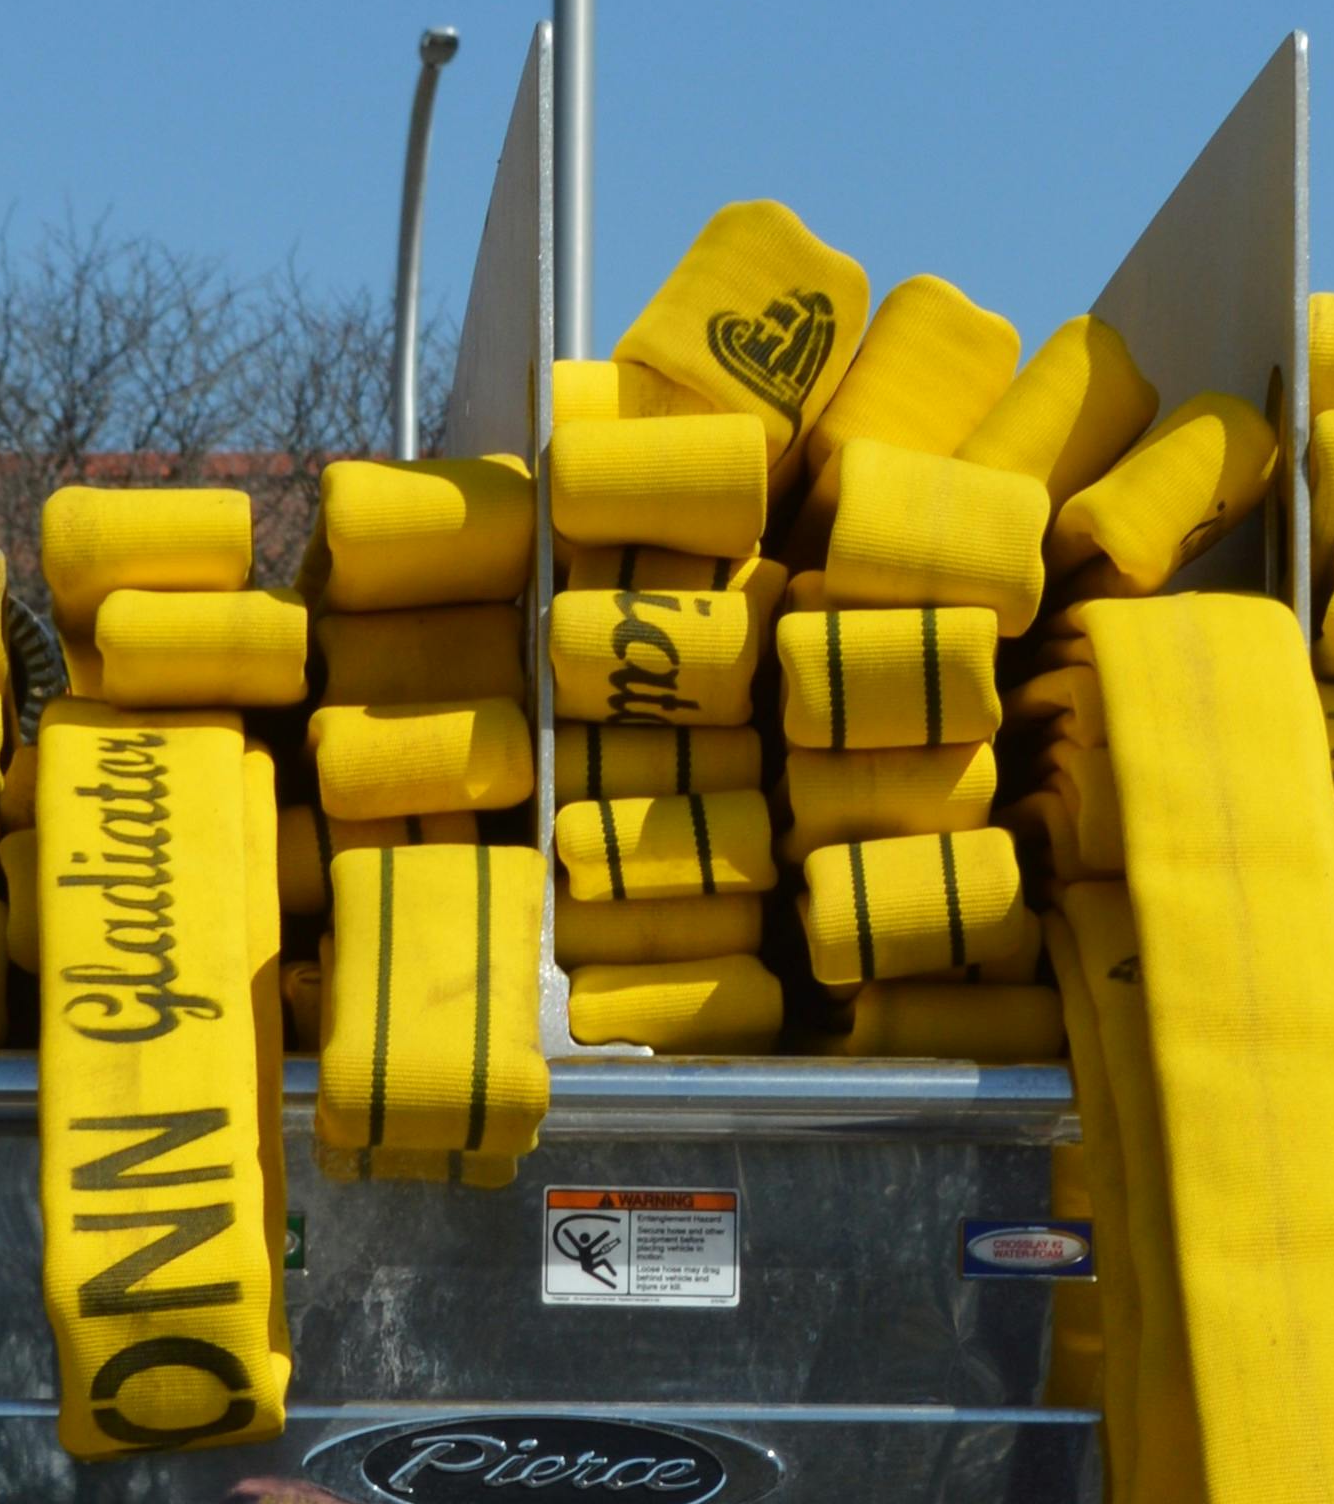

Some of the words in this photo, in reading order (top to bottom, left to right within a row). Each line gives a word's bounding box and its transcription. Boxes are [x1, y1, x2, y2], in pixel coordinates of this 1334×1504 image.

[57, 729, 223, 1046] Gladiator
[619, 1194, 694, 1207] WARNING
[637, 1214, 692, 1224] Entanglement
[694, 1215, 722, 1223] Hazard
[637, 1227, 664, 1235] Secure
[667, 1227, 687, 1235] hose
[688, 1227, 703, 1235] and
[637, 1236, 678, 1245] equipment
[993, 1240, 1048, 1249] CROSSLAY
[1052, 1241, 1063, 1249] #2
[683, 1267, 700, 1275] may
[702, 1266, 720, 1275] drag
[388, 1434, 701, 1494] Pierce
